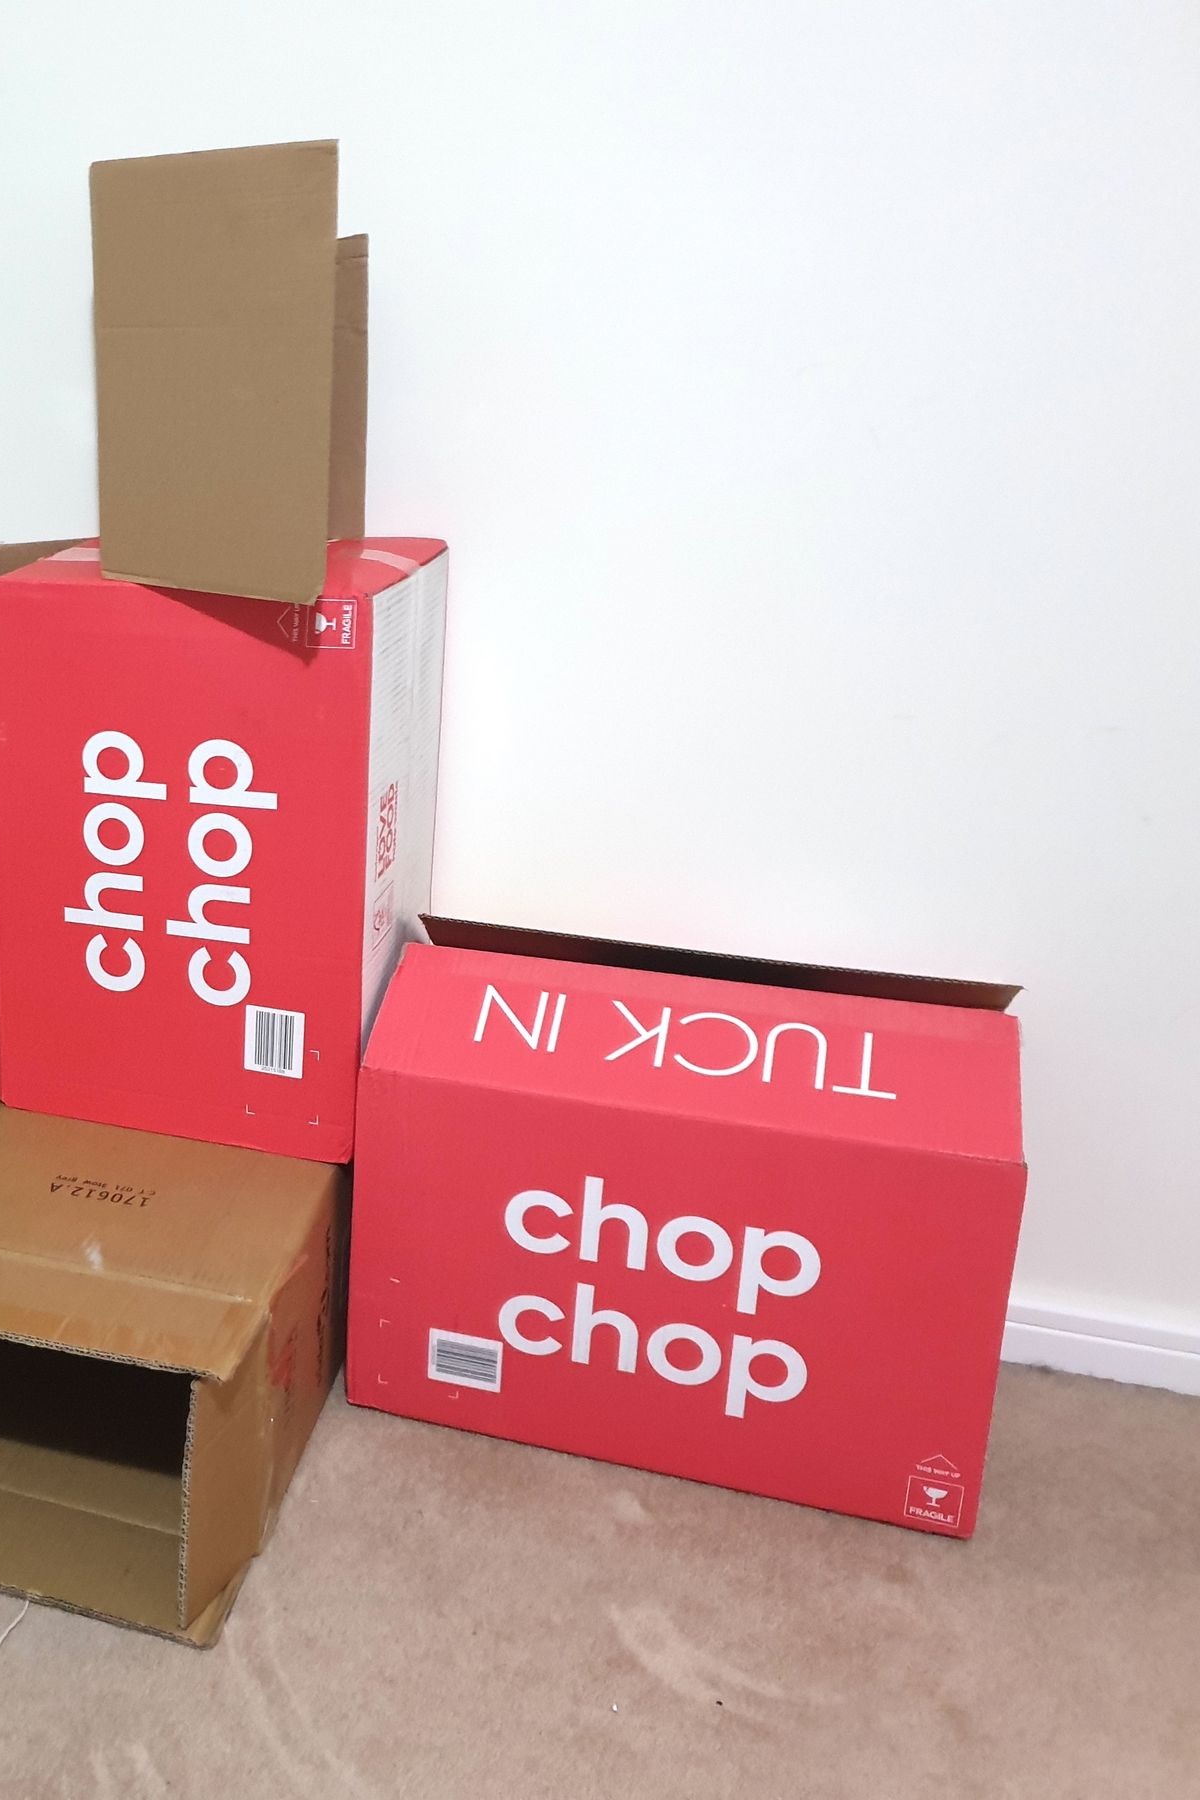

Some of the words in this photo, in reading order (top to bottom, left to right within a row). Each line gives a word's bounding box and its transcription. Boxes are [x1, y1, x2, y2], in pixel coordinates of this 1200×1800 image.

[341, 604, 353, 644] FRAGILE
[64, 731, 167, 992] chop
[377, 795, 389, 879] LOVE
[383, 783, 396, 870] FOOD
[167, 740, 278, 1007] chop
[474, 985, 567, 1053] IN
[605, 1001, 897, 1100] TUCK
[50, 1182, 151, 1207] 170612.A
[505, 1176, 822, 1315] chop
[499, 1283, 808, 1419] chop
[909, 1506, 955, 1523] FRAGILE
